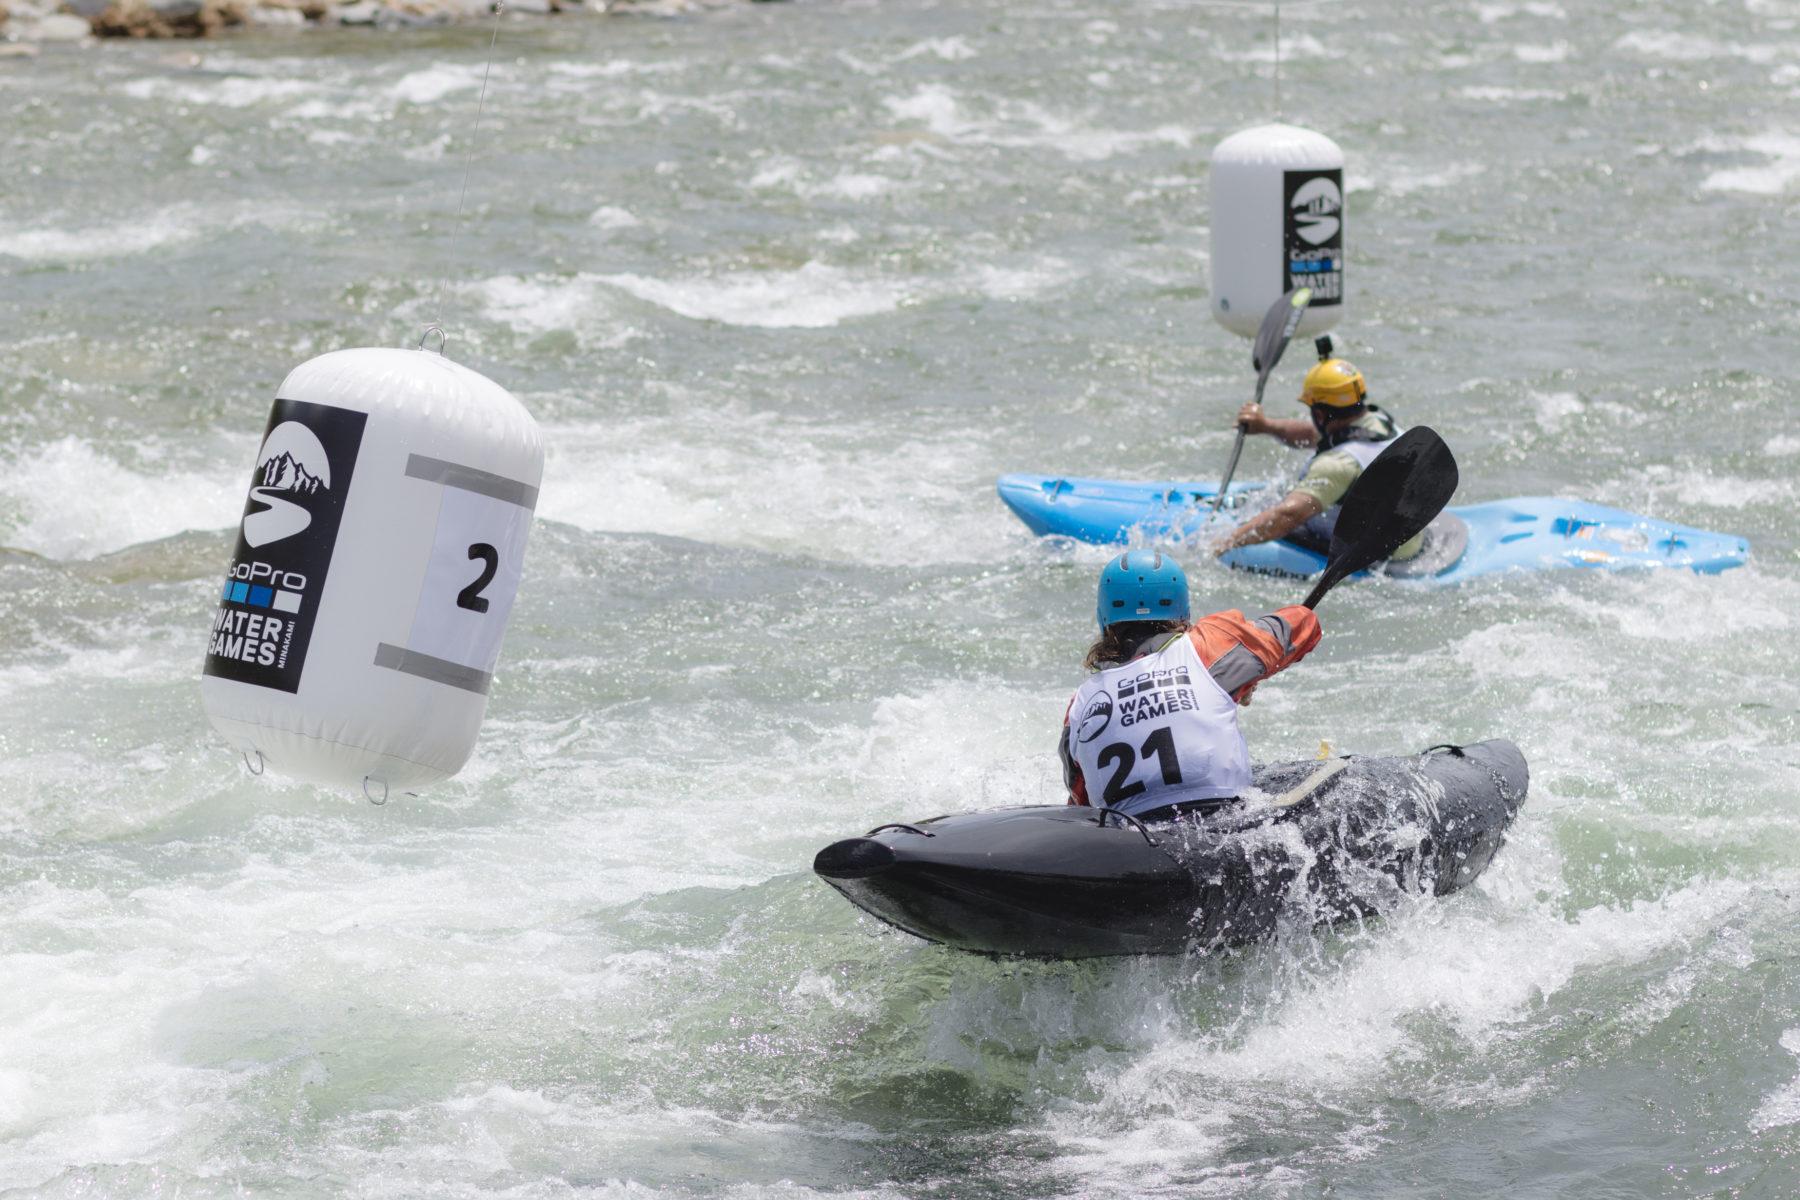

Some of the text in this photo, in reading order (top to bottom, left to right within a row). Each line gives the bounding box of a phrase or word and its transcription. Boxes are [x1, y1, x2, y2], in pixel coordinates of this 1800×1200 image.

[227, 558, 307, 590] GoPro
[456, 542, 499, 614] 2
[214, 608, 283, 642] WATER
[208, 632, 277, 666] GAMES
[277, 621, 296, 669] MINAKAMI
[1118, 688, 1191, 714] WATER
[1120, 699, 1194, 727] GAMES
[1097, 726, 1183, 806] 21
